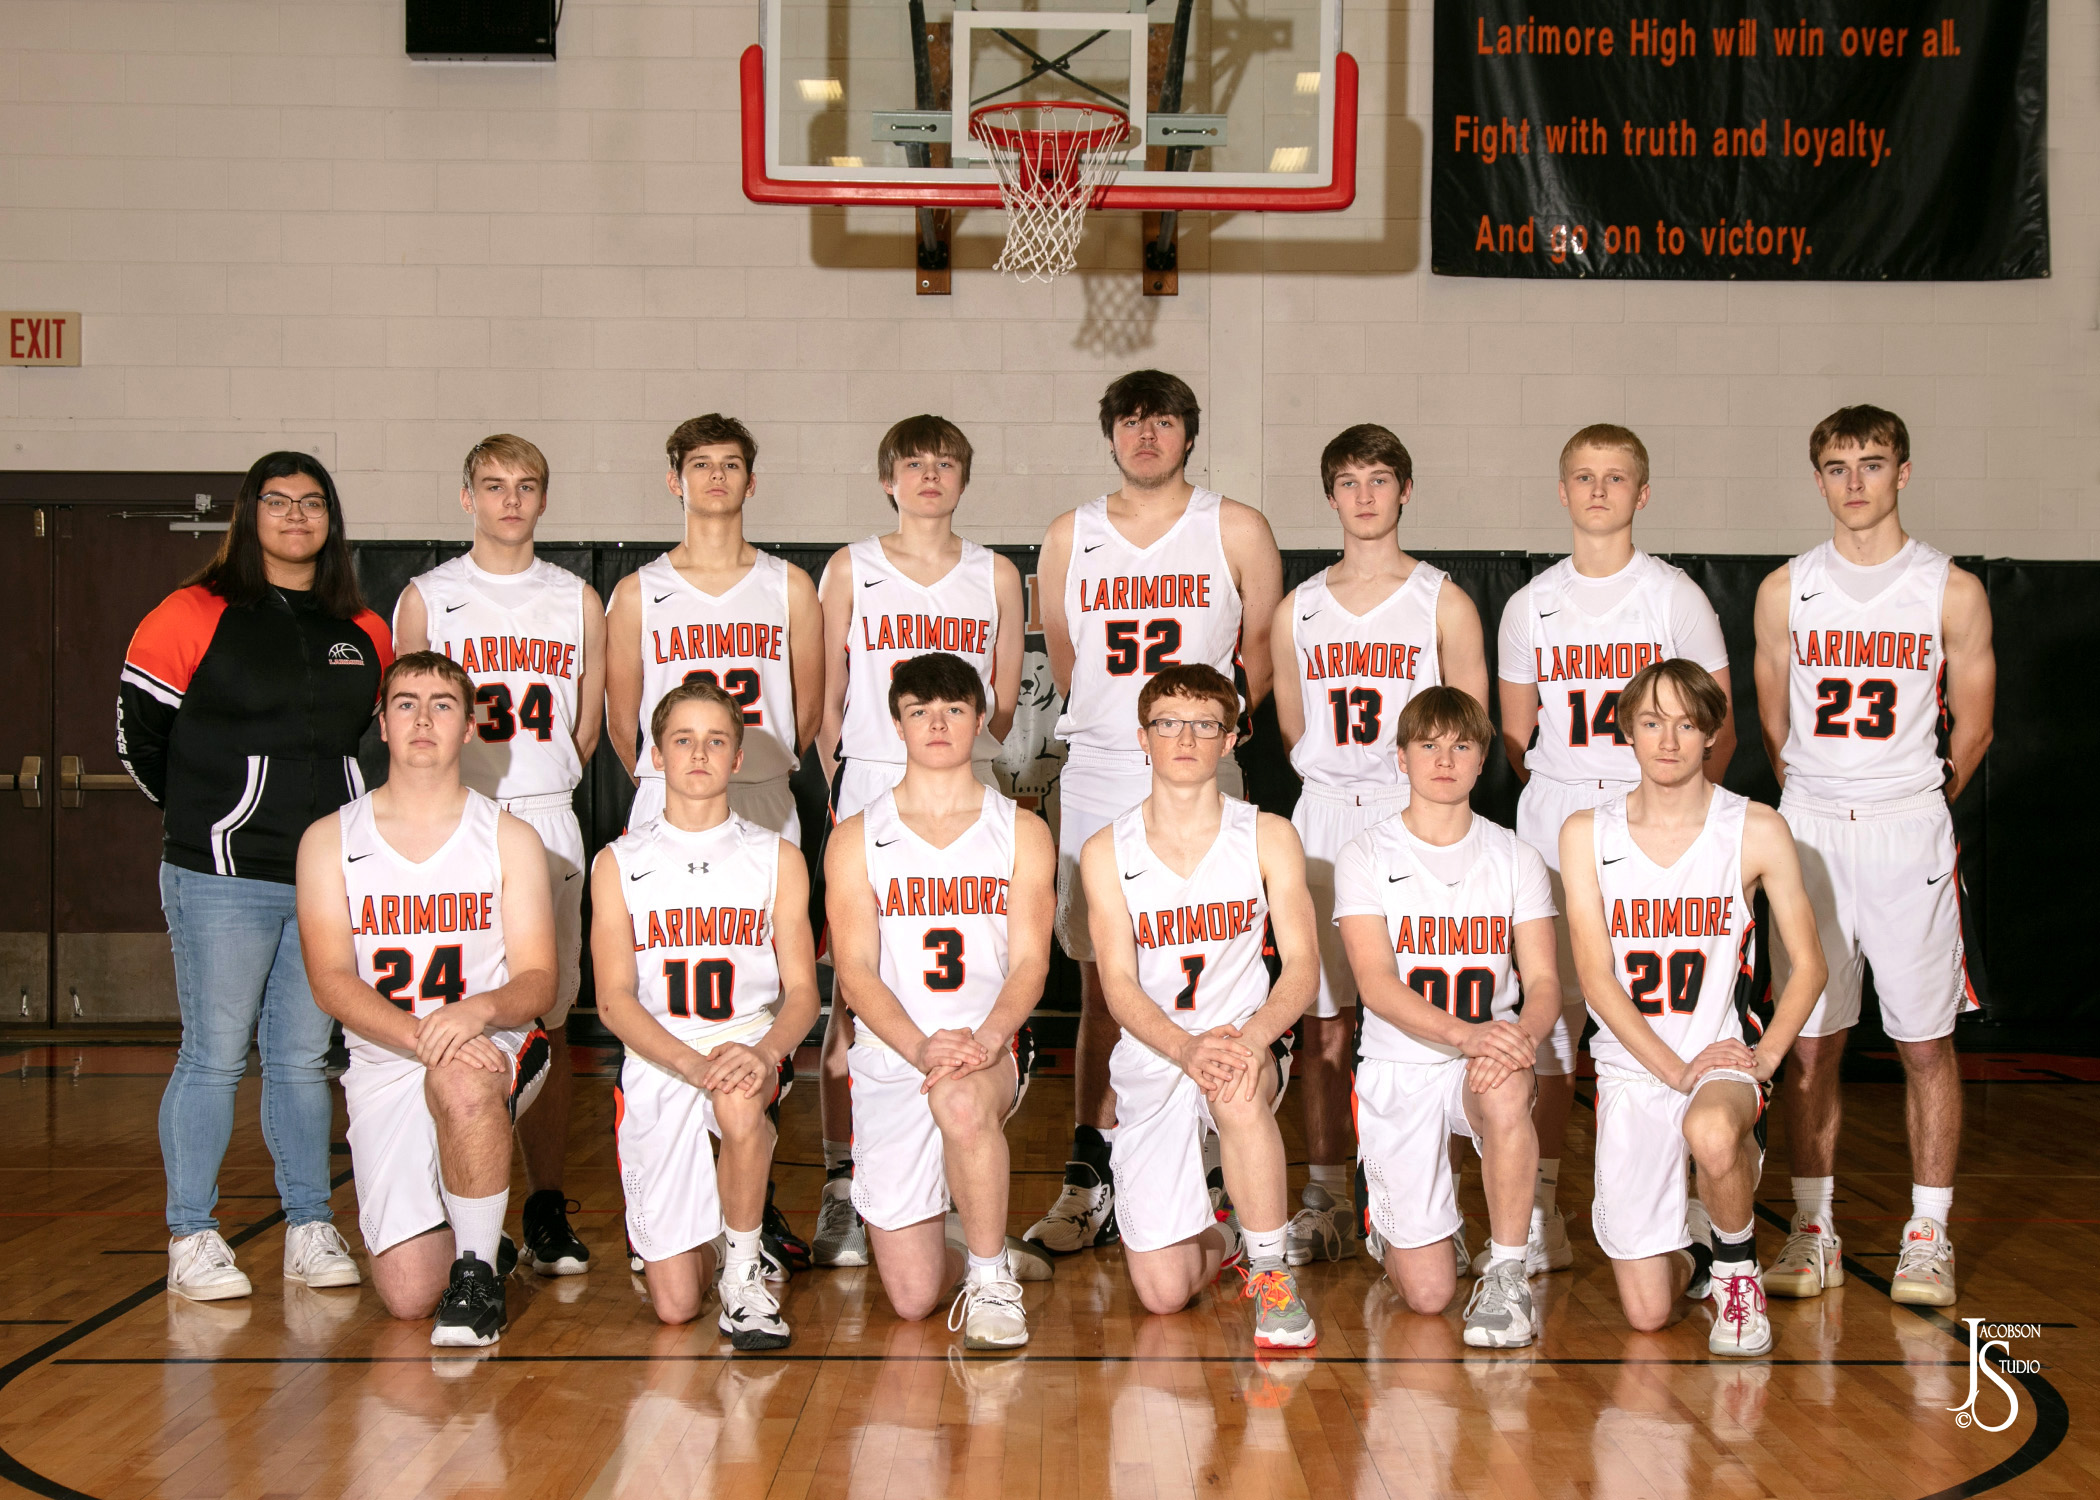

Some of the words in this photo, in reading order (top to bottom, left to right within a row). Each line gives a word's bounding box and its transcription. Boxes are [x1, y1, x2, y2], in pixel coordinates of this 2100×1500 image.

[1477, 16, 1614, 57] Larimore
[1630, 18, 1697, 67] High
[1712, 18, 1757, 57] will
[1773, 18, 1824, 57] win
[1840, 27, 1909, 58] over
[1922, 19, 1962, 58] all.
[1454, 114, 1530, 165] Fight
[1545, 116, 1608, 155] with
[1622, 119, 1697, 157] truth
[1712, 119, 1767, 158] and
[1783, 118, 1892, 168] loyalty.
[1474, 214, 1534, 254] And
[1550, 224, 1589, 265] go
[1604, 224, 1641, 255] on
[1655, 219, 1685, 256] to
[1700, 217, 1813, 265] victory.
[10, 317, 67, 359] EXIT
[1080, 573, 1211, 613] LARIMORE
[652, 622, 784, 665] LARIMORE
[862, 614, 991, 655] LARIMORE
[1104, 617, 1183, 677] 52
[1303, 641, 1422, 681] LARIMORE
[1793, 630, 1933, 671] LARIMORE
[474, 682, 555, 744] 34
[681, 667, 763, 727] 2
[1327, 686, 1384, 747] 13
[1567, 688, 1635, 748] 14
[1813, 677, 1899, 740] 23
[875, 876, 1008, 917] ARIMORE
[1603, 895, 1734, 939] ARIMORE
[1134, 897, 1259, 950] ARIMORE
[1387, 915, 1514, 955] ARIMOR
[372, 943, 467, 1014] 24
[922, 927, 966, 993] 3
[1623, 948, 1708, 1017] 20
[662, 957, 736, 1022] 10
